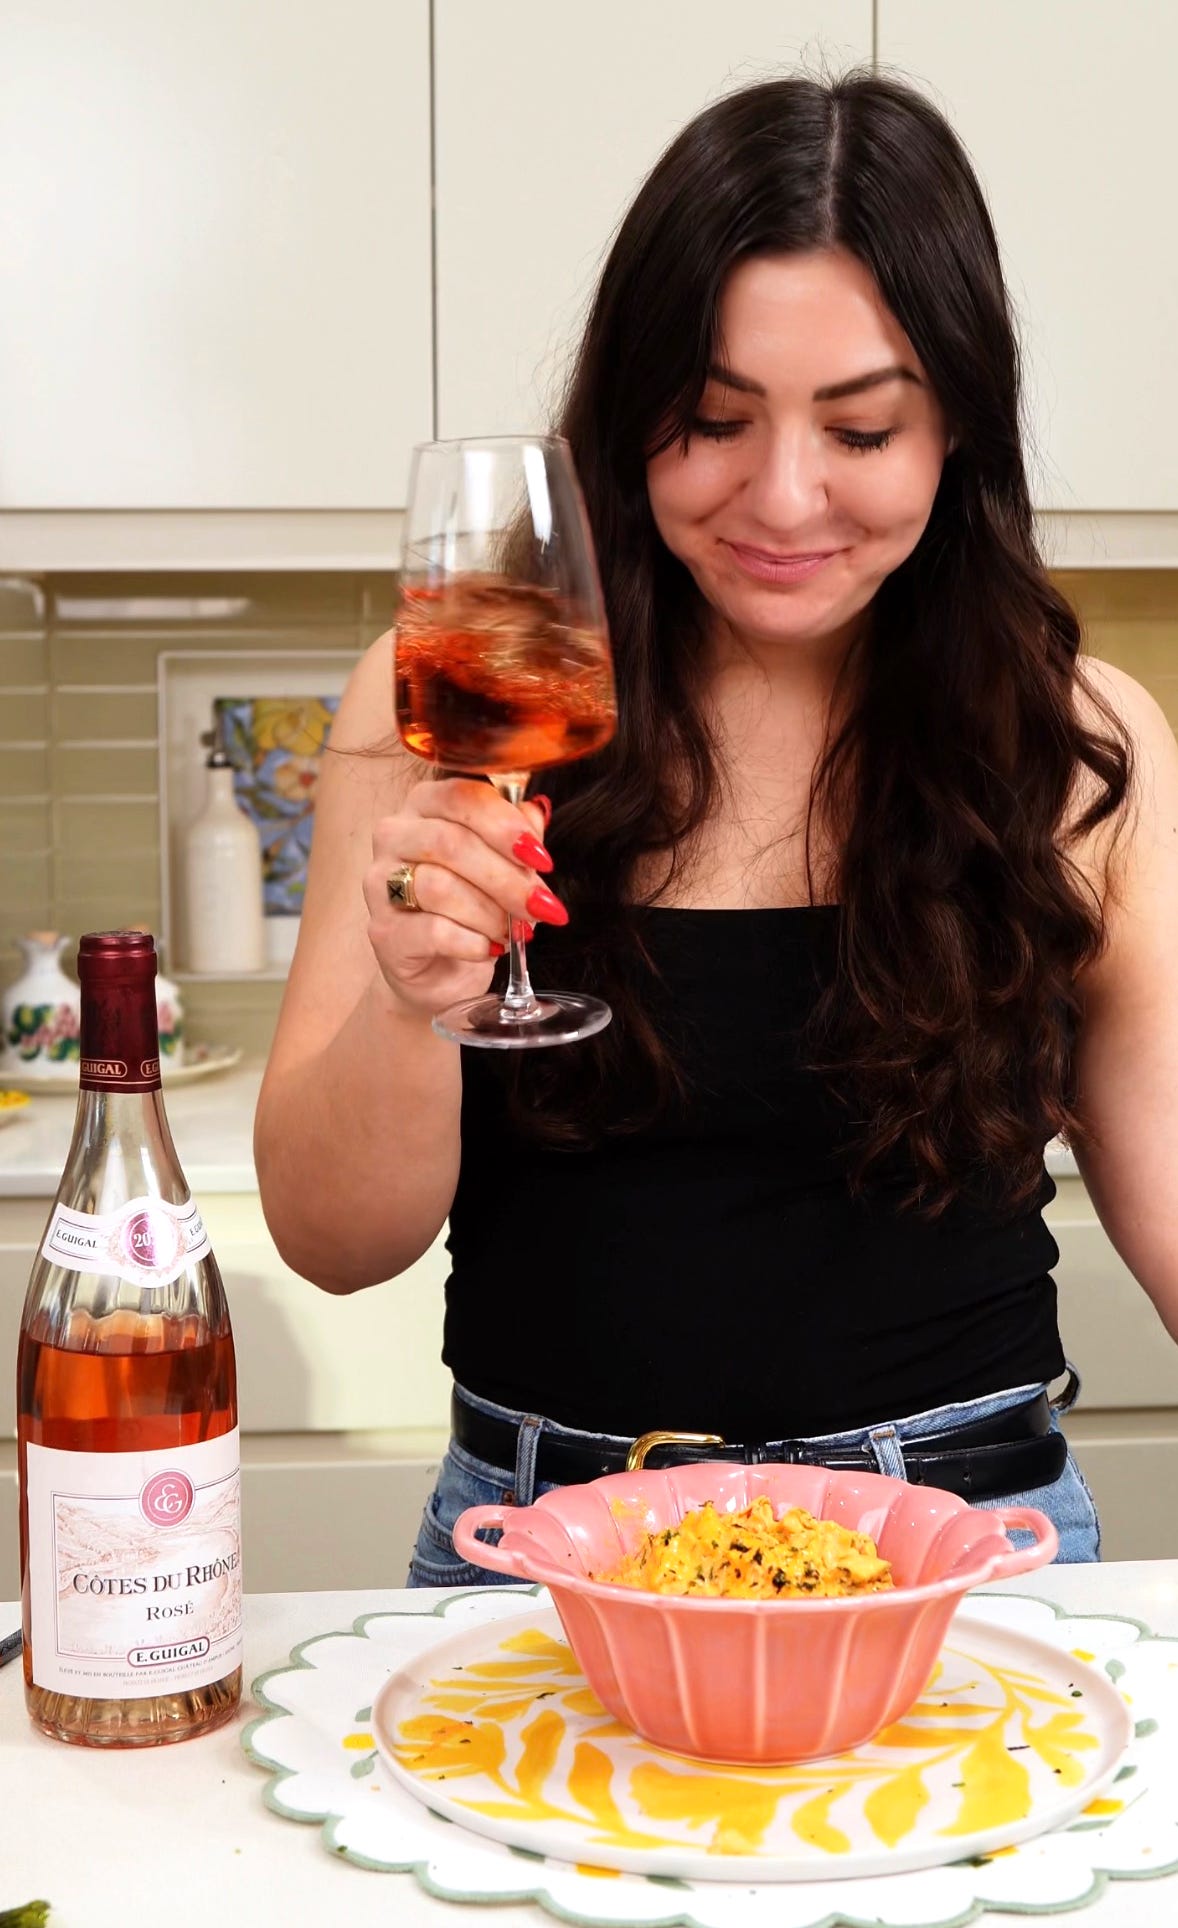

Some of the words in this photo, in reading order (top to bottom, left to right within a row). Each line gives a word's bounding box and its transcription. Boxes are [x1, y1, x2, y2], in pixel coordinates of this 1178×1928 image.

[73, 1573, 147, 1596] CÔTES
[153, 1572, 182, 1593] DU
[185, 1551, 238, 1588] RHÔNE
[146, 1601, 195, 1622] ROSÉ
